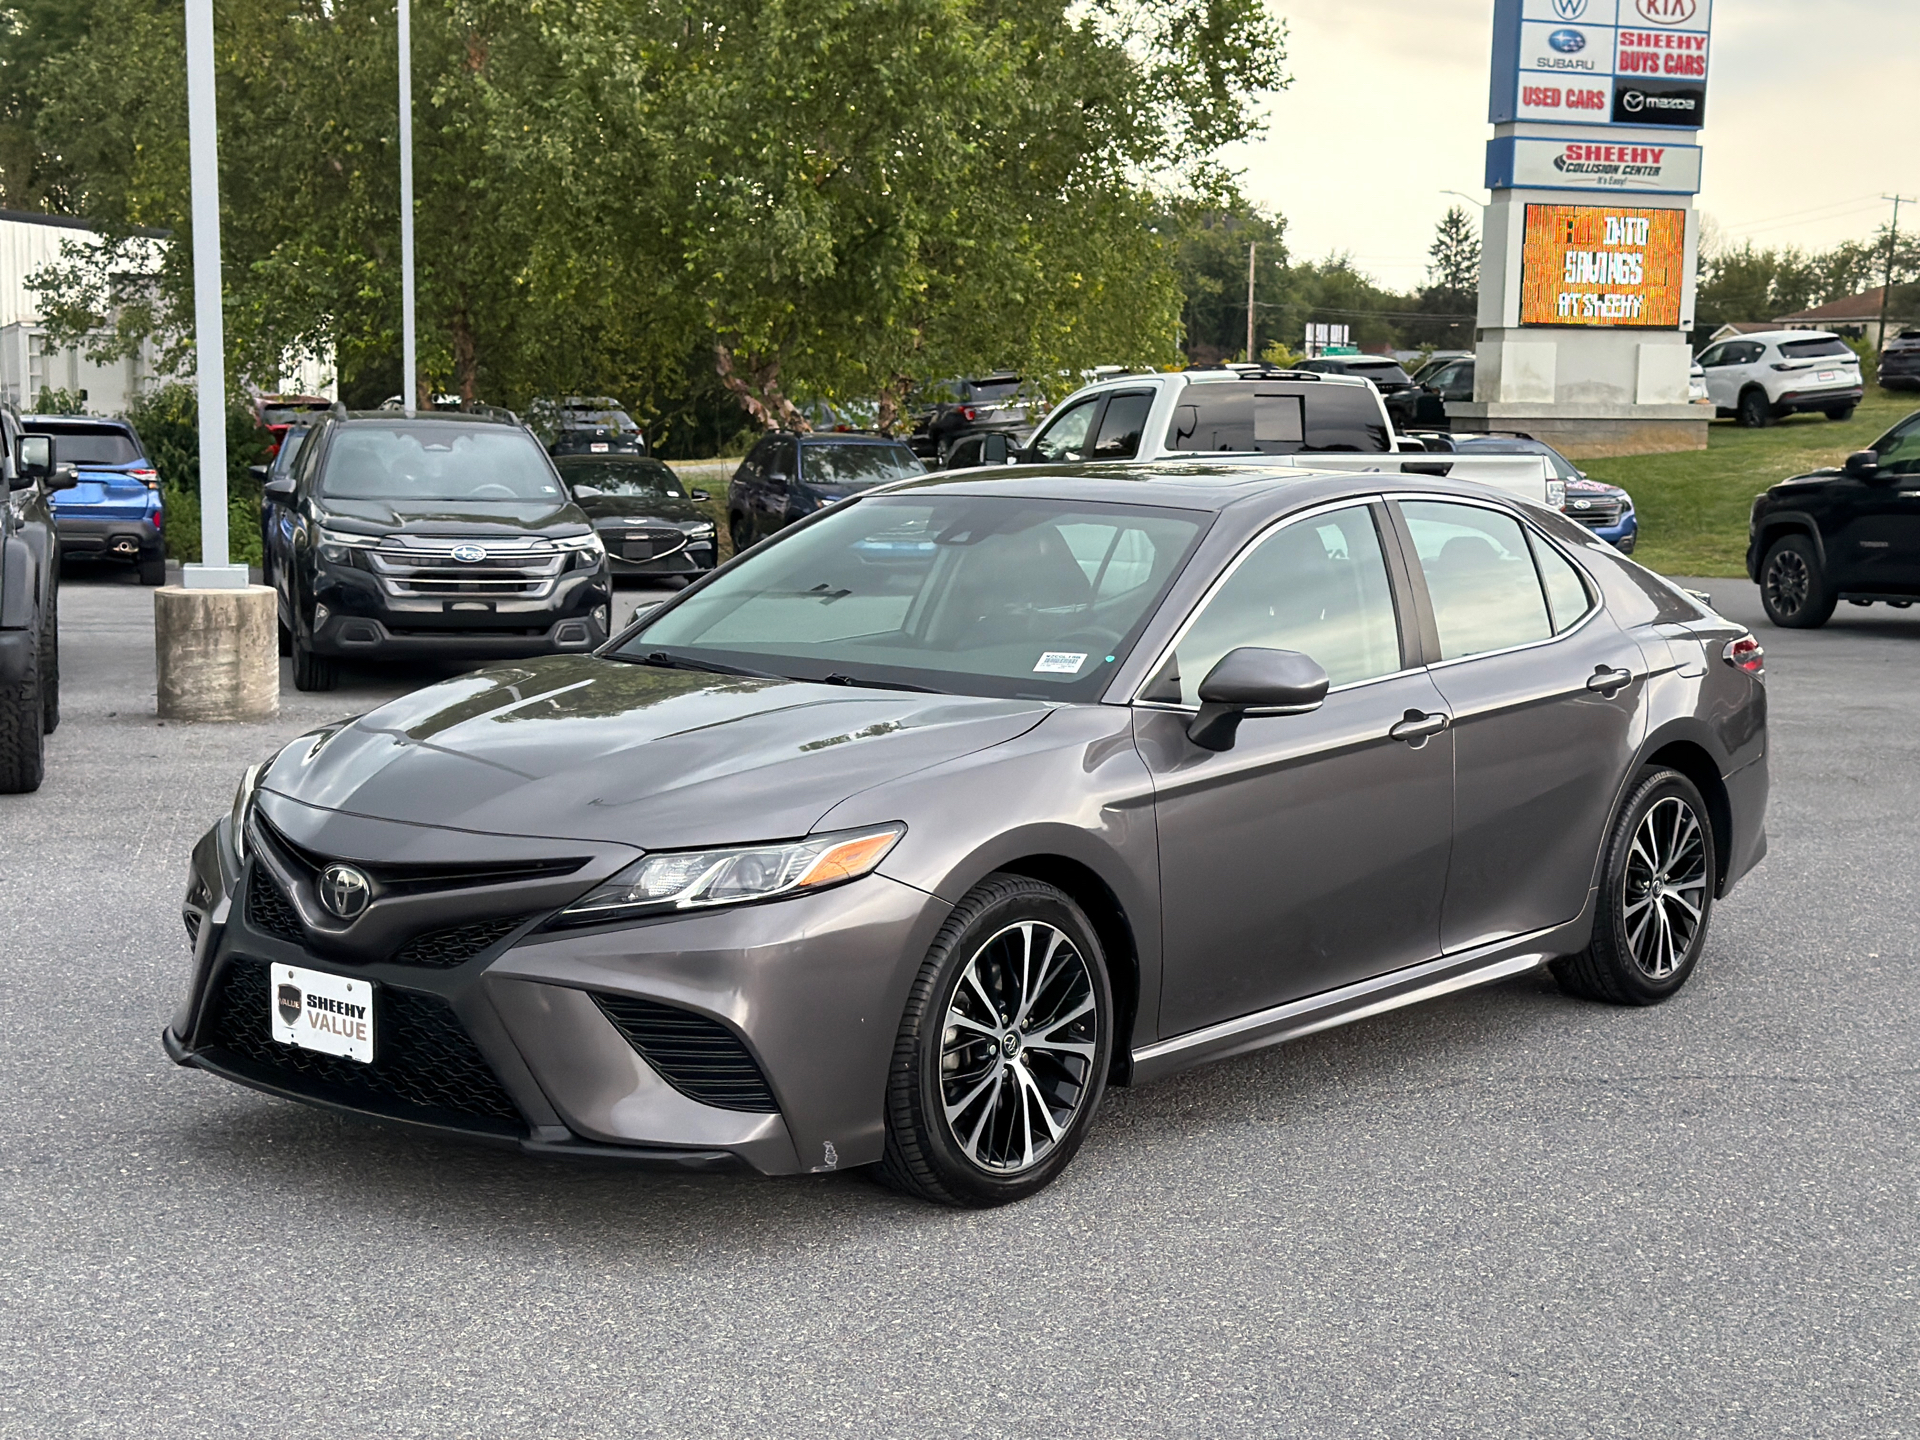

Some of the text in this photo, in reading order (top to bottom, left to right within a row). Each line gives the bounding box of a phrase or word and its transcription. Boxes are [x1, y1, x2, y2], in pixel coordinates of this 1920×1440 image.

[1619, 32, 1706, 51] SHEEHY
[1537, 57, 1595, 71] SUBARU
[1618, 51, 1705, 77] BUYS CARS
[1522, 86, 1606, 110] USED CARS
[1646, 97, 1695, 110] mazda
[1565, 144, 1665, 164] SHEEHY
[1565, 162, 1662, 177] COLLISION CENTER
[1558, 292, 1581, 317] AT
[279, 997, 300, 1009] VALUE
[306, 993, 367, 1020] SHEEHY
[307, 1009, 367, 1042] VALUE
